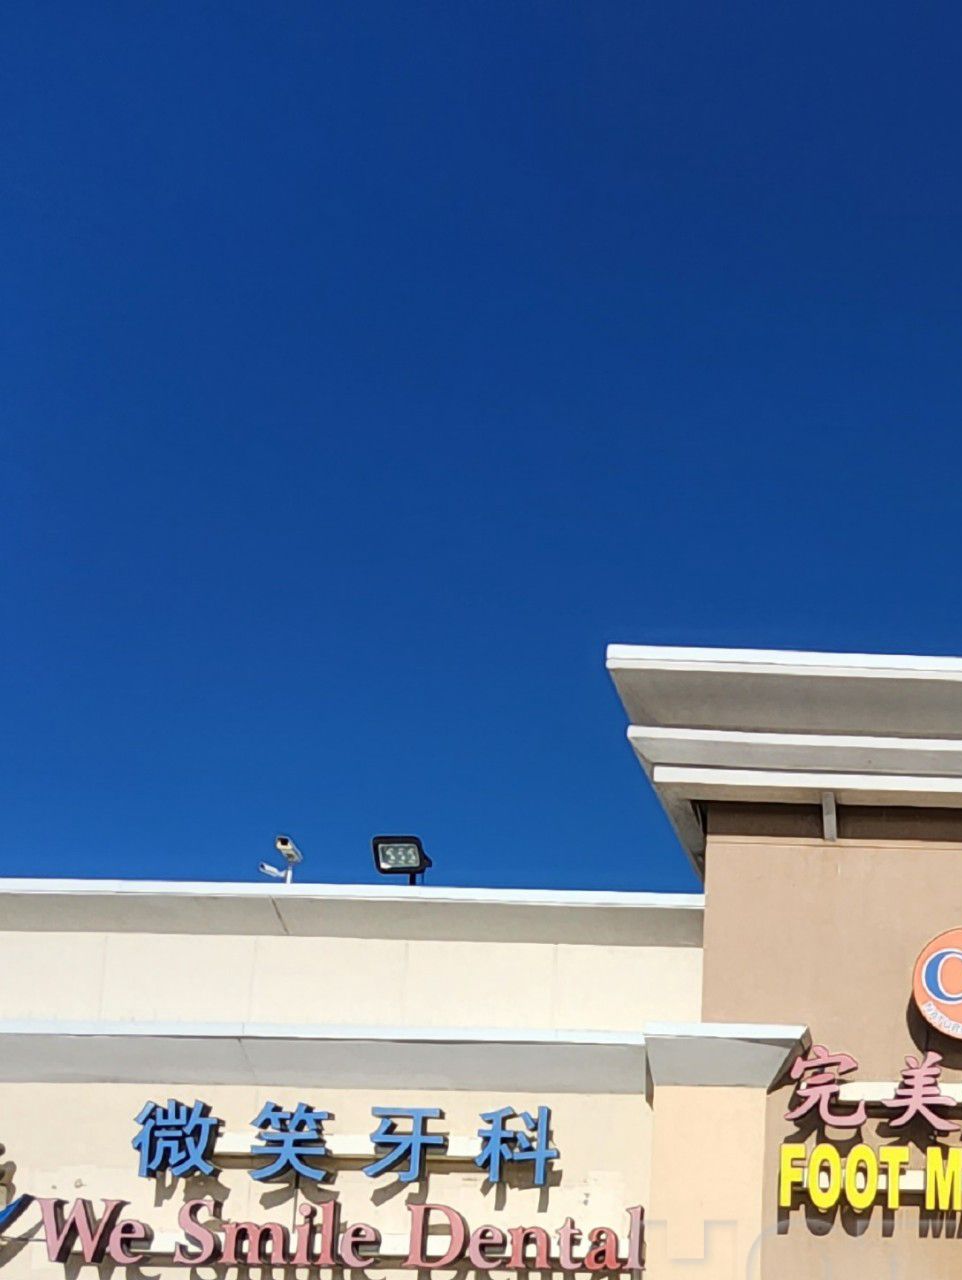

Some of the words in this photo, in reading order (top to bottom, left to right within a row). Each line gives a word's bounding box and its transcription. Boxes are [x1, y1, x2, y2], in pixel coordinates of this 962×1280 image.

[132, 1099, 560, 1186] 微笑牙科
[779, 1143, 909, 1209] FOOT
[37, 1198, 147, 1264] We
[173, 1199, 378, 1270] Smile
[402, 1203, 646, 1270] Dental
